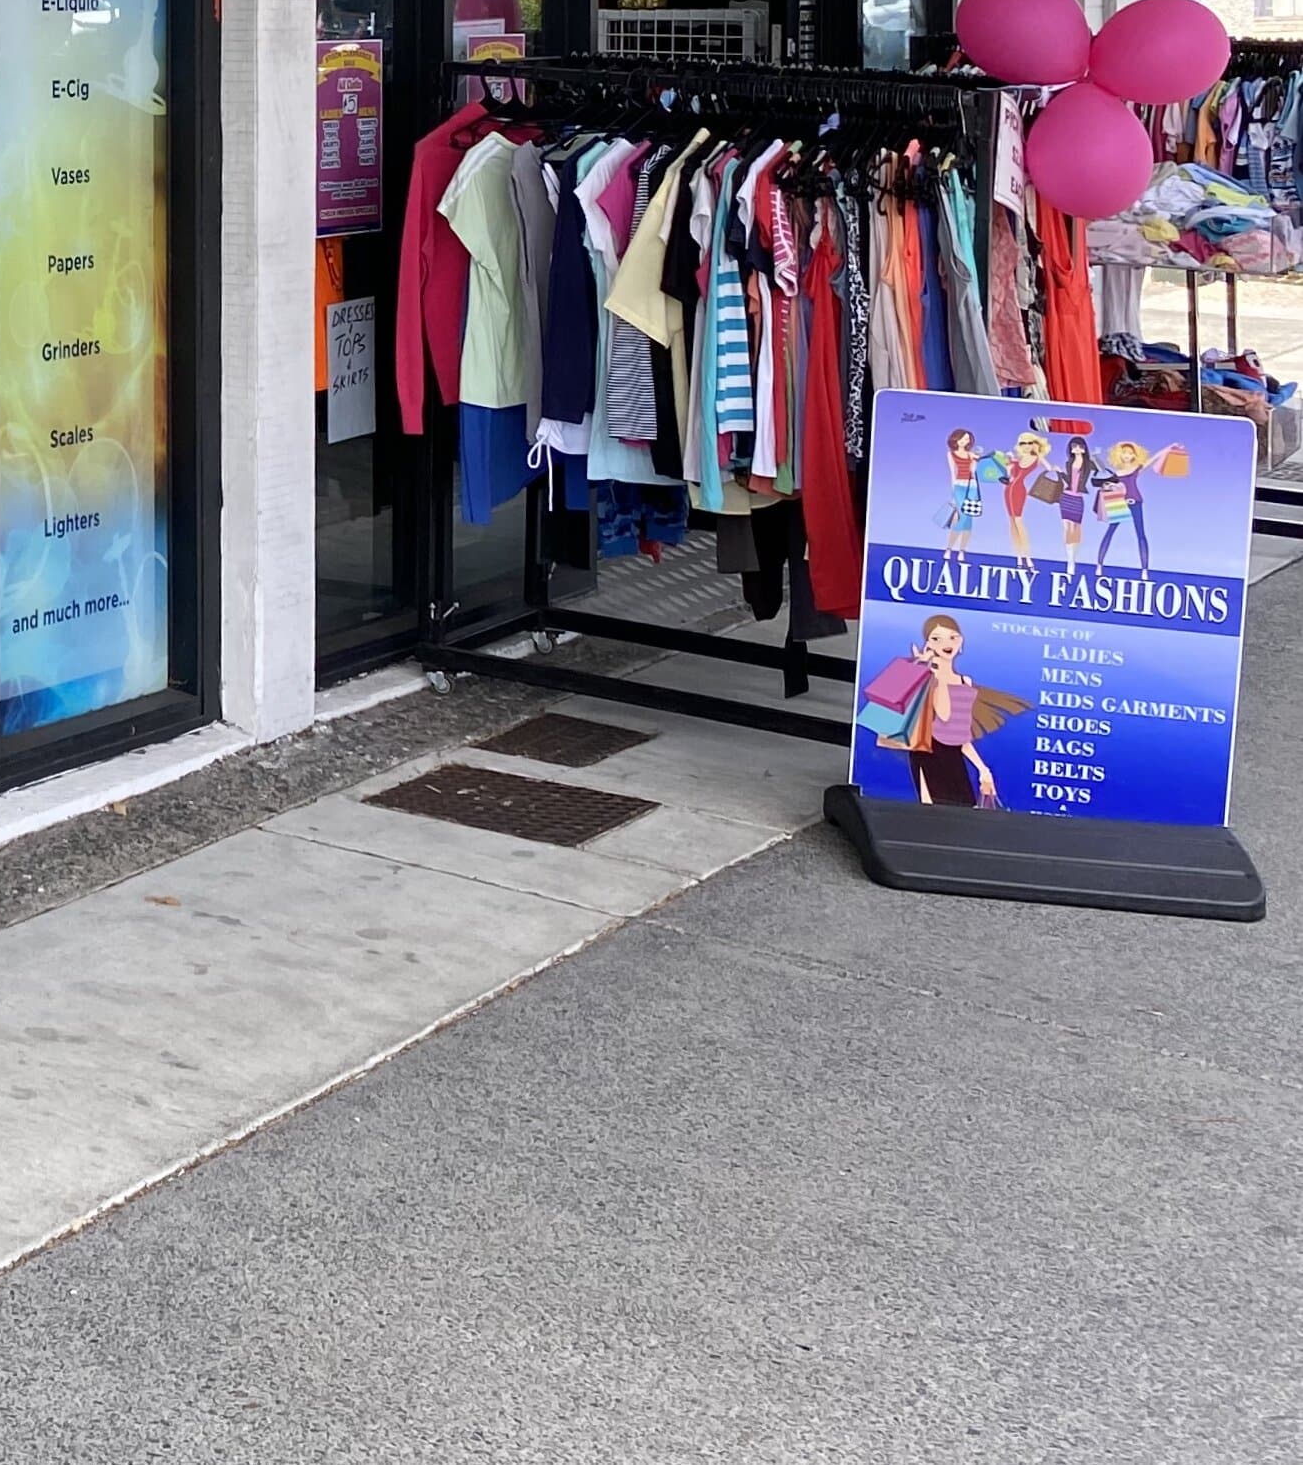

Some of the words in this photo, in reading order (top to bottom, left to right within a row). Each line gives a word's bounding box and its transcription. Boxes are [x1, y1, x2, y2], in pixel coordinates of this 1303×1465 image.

[52, 79, 90, 100] E-Cig
[51, 167, 91, 186] Vases
[48, 253, 95, 275] Papers
[42, 339, 101, 362] Grinders
[335, 333, 367, 359] TOPS
[50, 425, 94, 448] Scales
[44, 512, 100, 538] Lighters
[882, 555, 1042, 605] QUALITY
[1048, 571, 1229, 624] FASHIONS
[12, 609, 39, 634] and
[43, 602, 81, 627] much
[84, 595, 130, 618] more...
[992, 621, 1069, 641] STOCKIST
[1072, 627, 1095, 642] OF
[1042, 642, 1125, 667] LADIES
[1040, 666, 1103, 689] MENS
[1039, 689, 1095, 711] KIDS
[1101, 697, 1227, 726] GARMENTS
[1036, 713, 1112, 737] SHOES
[1035, 736, 1095, 758] BAGS
[1033, 760, 1106, 783] BELTS
[1031, 782, 1092, 805] TOYS
